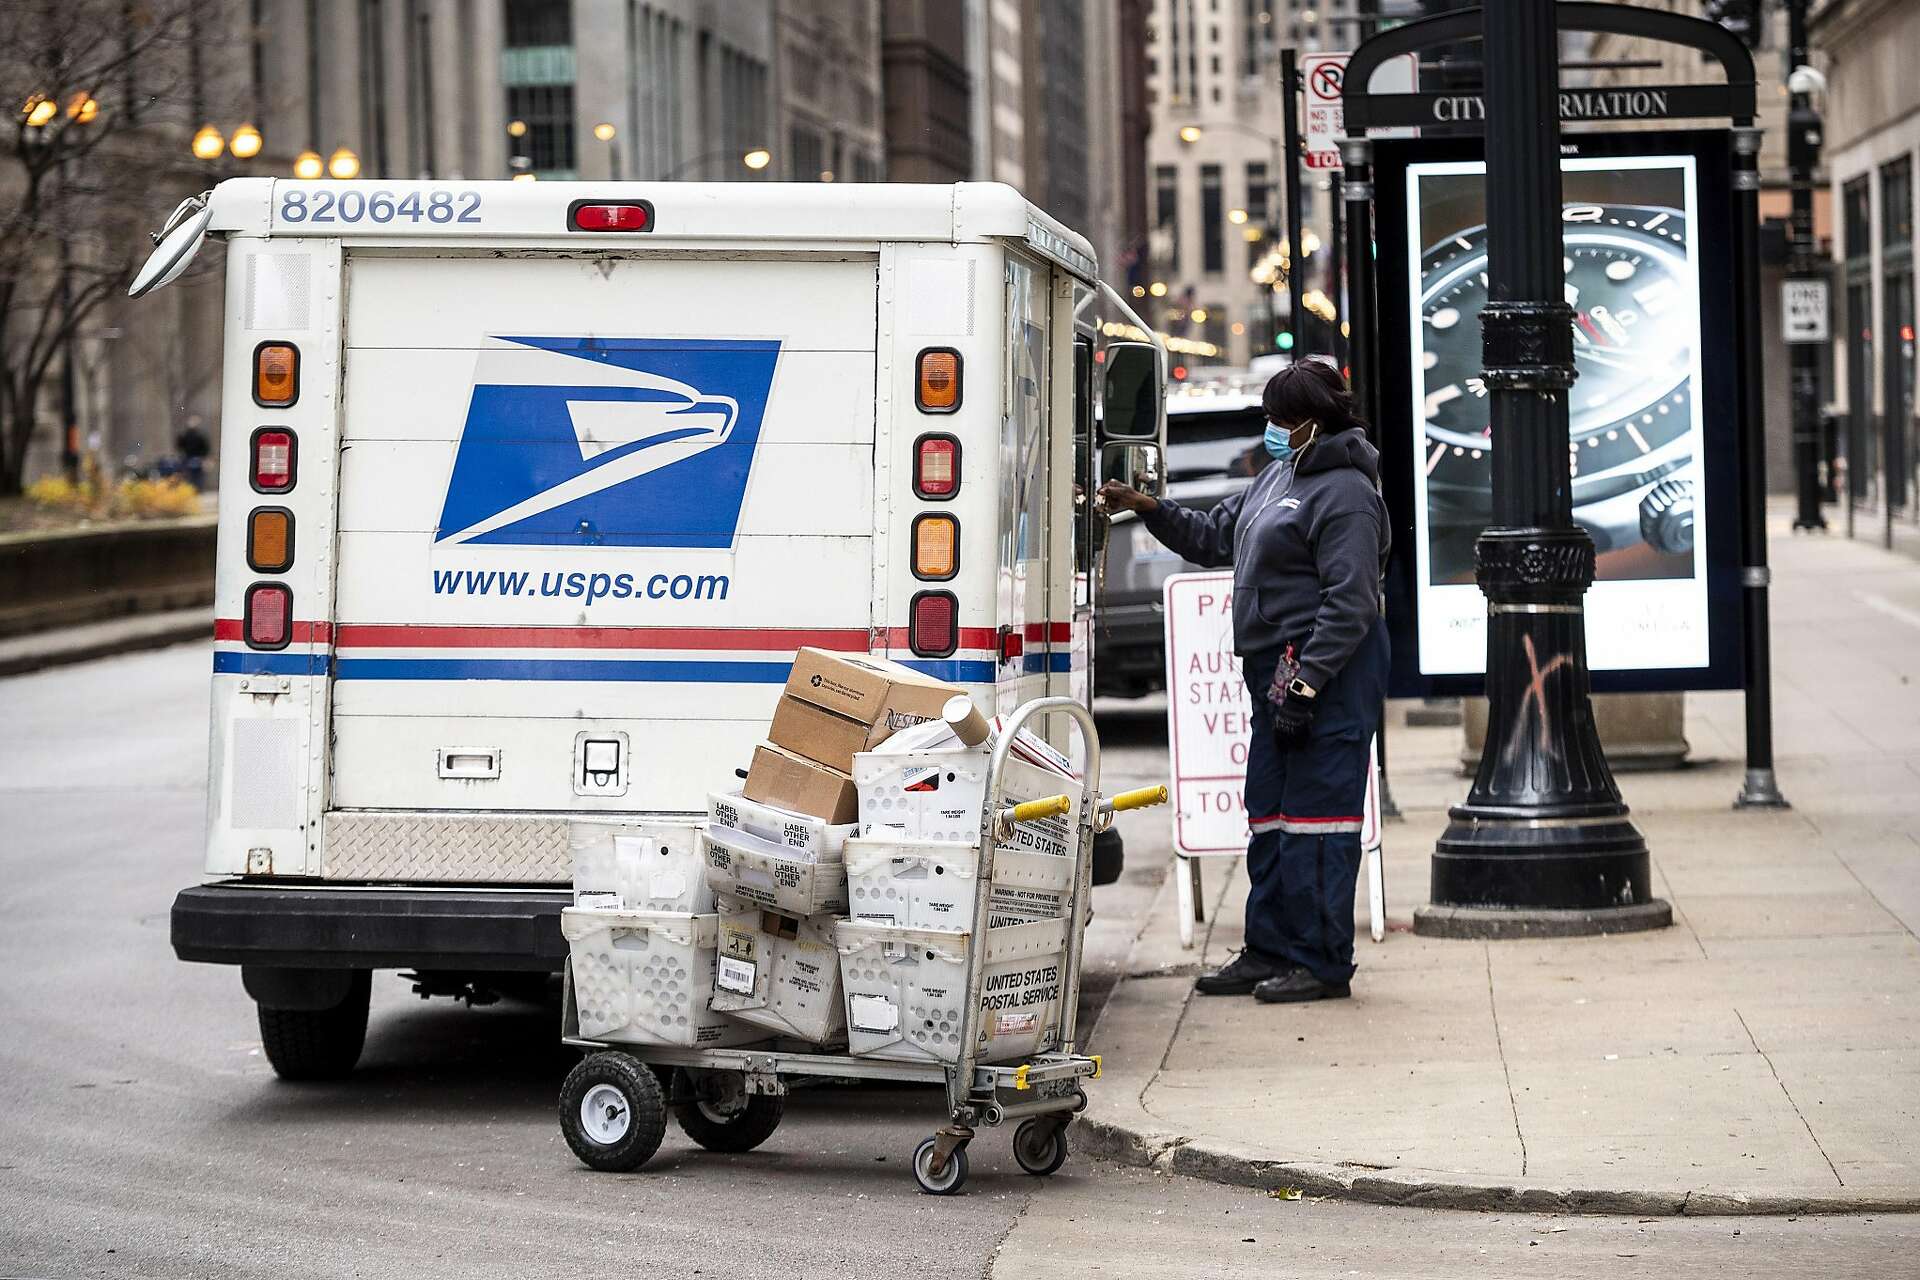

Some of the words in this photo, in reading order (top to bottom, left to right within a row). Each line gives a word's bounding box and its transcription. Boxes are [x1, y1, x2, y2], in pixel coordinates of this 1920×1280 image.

[1433, 96, 1485, 121] CITY
[1559, 91, 1668, 117] RMATION
[281, 190, 482, 223] 8206482
[433, 569, 730, 606] www.usps.com
[1198, 594, 1234, 616] PA
[1189, 651, 1235, 674] AUT
[1190, 681, 1245, 705] STAT
[715, 809, 739, 823] OTHER
[716, 802, 738, 816] LABEL
[719, 818, 735, 829] END
[784, 822, 809, 835] LABEL
[783, 830, 810, 842] OTHER
[788, 838, 805, 848] END
[710, 843, 731, 857] LABEL
[1035, 836, 1067, 857] STATES
[709, 851, 731, 865] OTHER
[714, 860, 728, 870] END
[774, 870, 800, 882] OTHER
[775, 863, 800, 875] LABEL
[780, 878, 797, 888] END
[986, 972, 1023, 992] UNITED
[1023, 965, 1058, 987] STATES
[980, 992, 1020, 1012] POSTAL
[1021, 985, 1060, 1006] SERVICE
